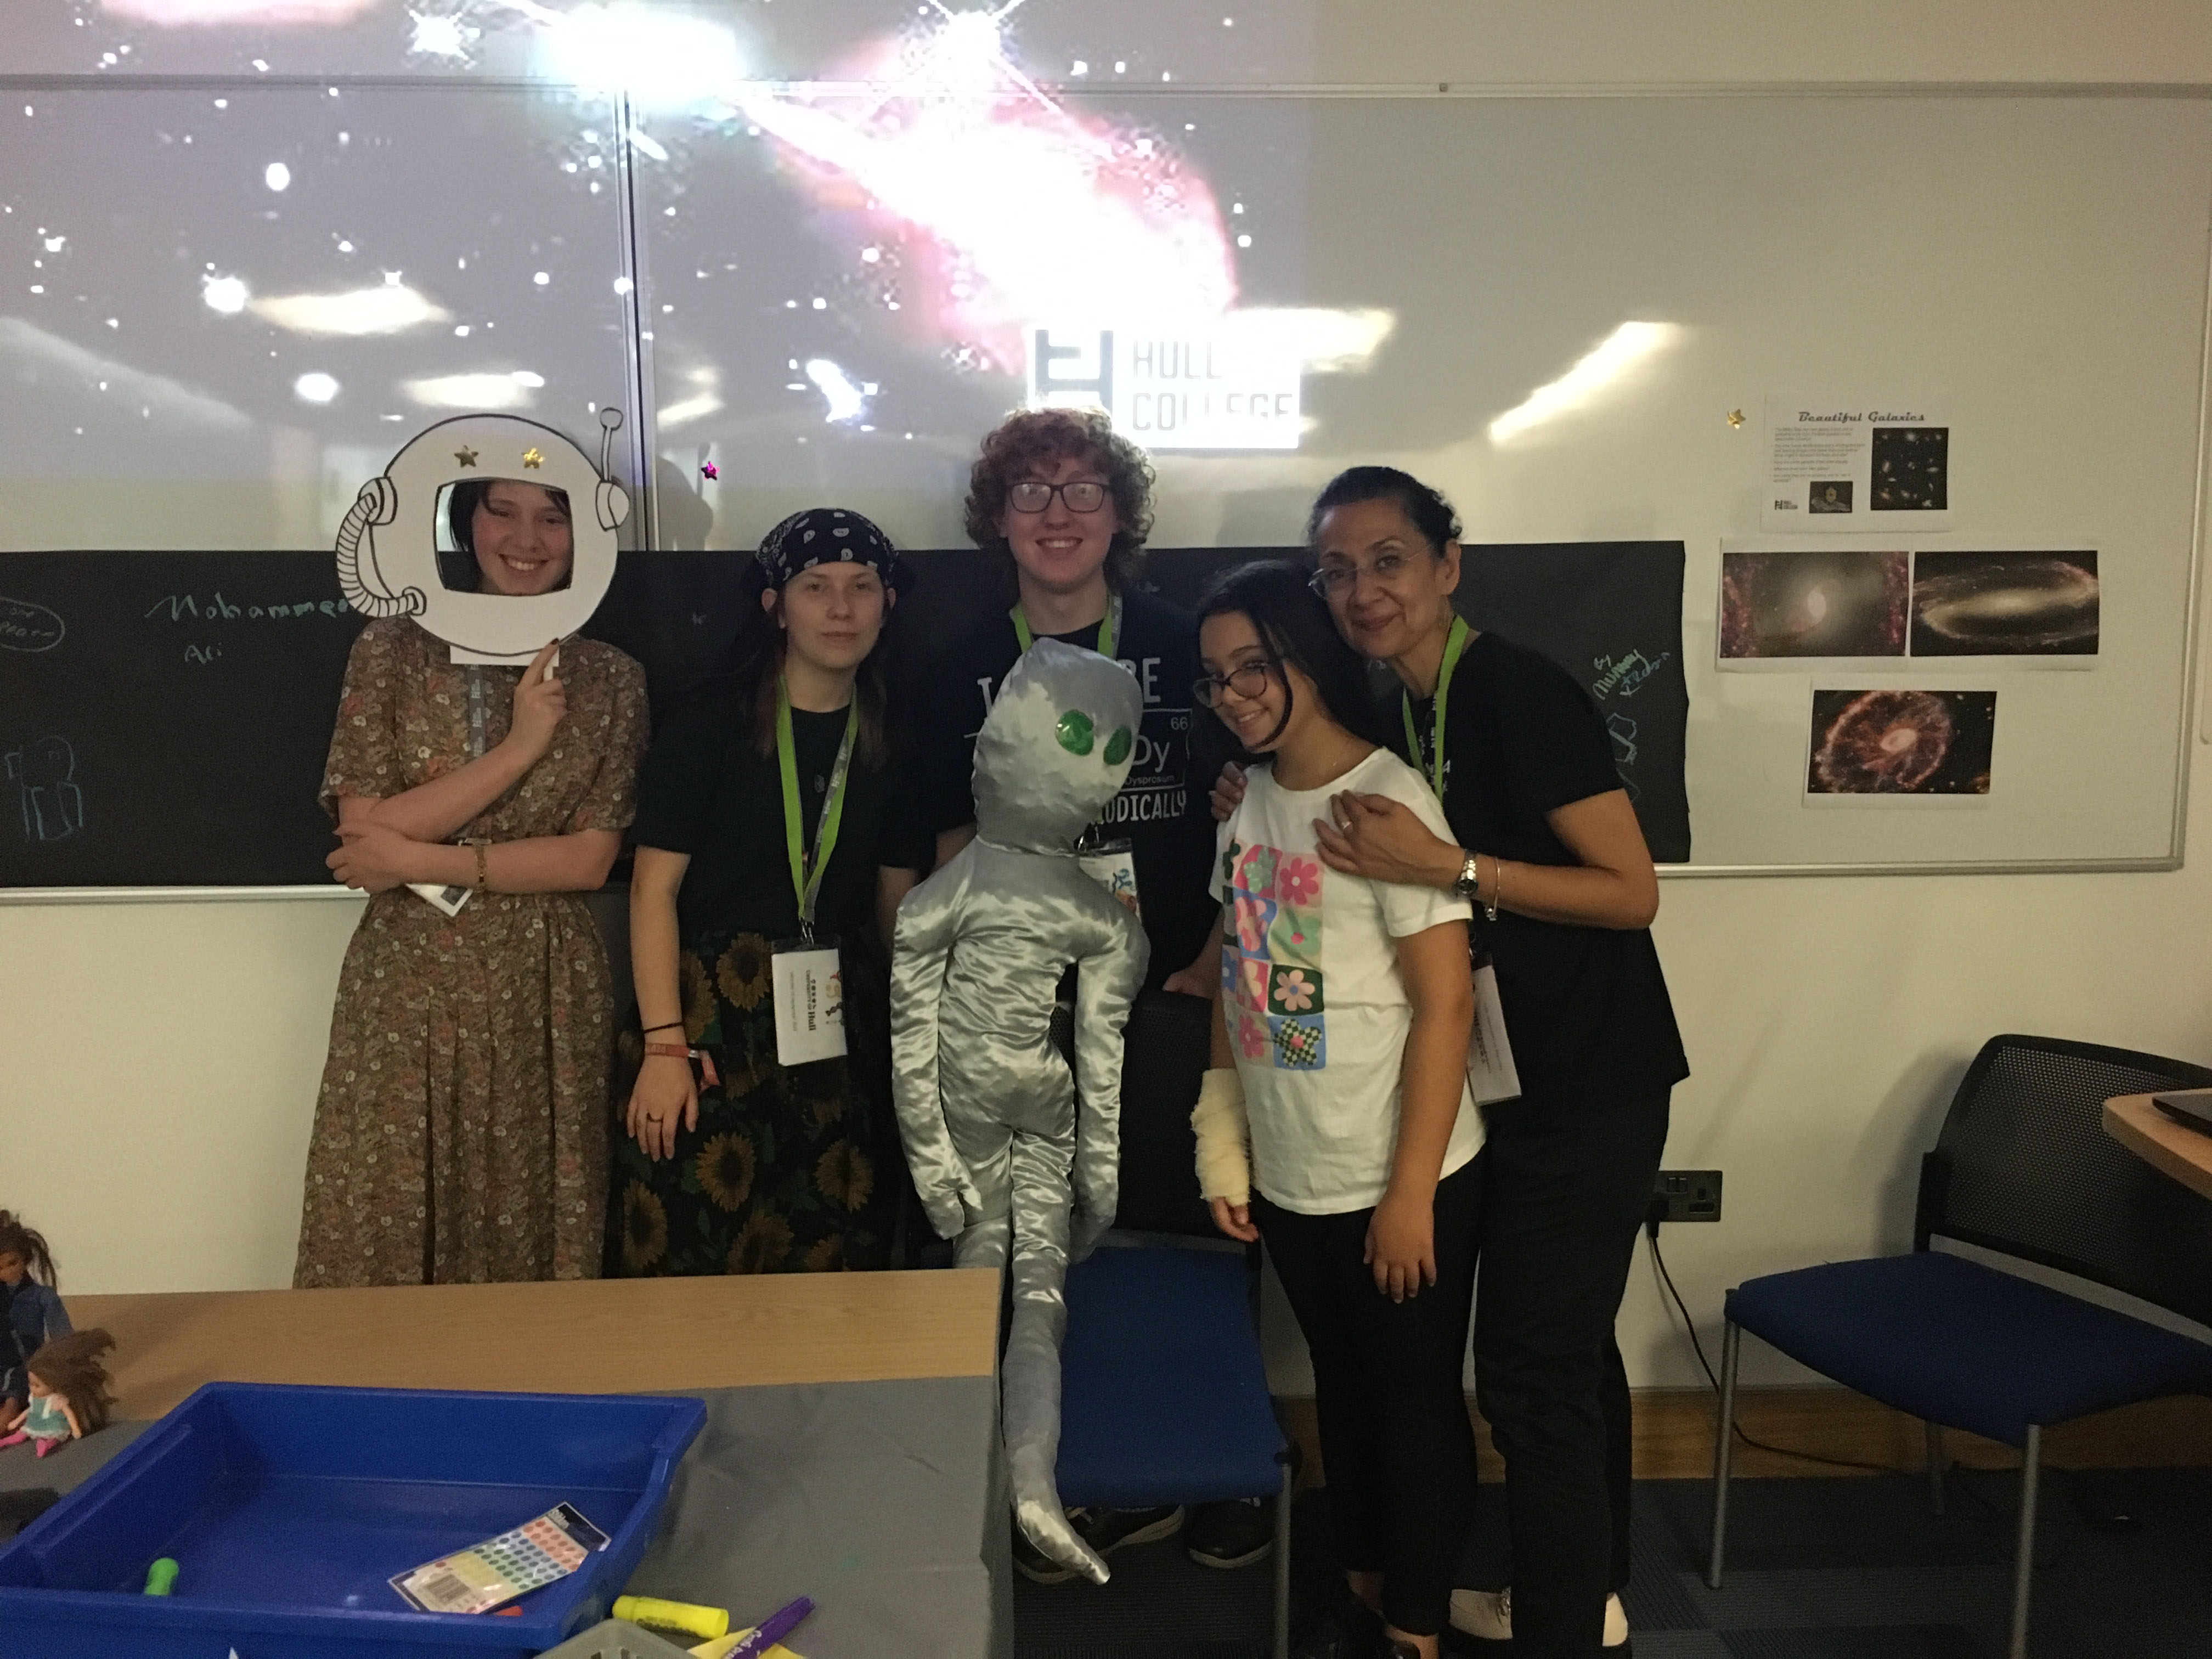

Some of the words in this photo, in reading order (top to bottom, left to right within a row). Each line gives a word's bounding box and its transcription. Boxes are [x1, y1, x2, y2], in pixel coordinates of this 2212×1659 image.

[1133, 340, 1223, 380] HULL
[1798, 411, 1862, 424] Beautiful
[1868, 411, 1925, 423] Galaxies
[1171, 717, 1188, 730] 66
[1132, 734, 1170, 773] Dy
[1101, 789, 1187, 825] ODICALLY
